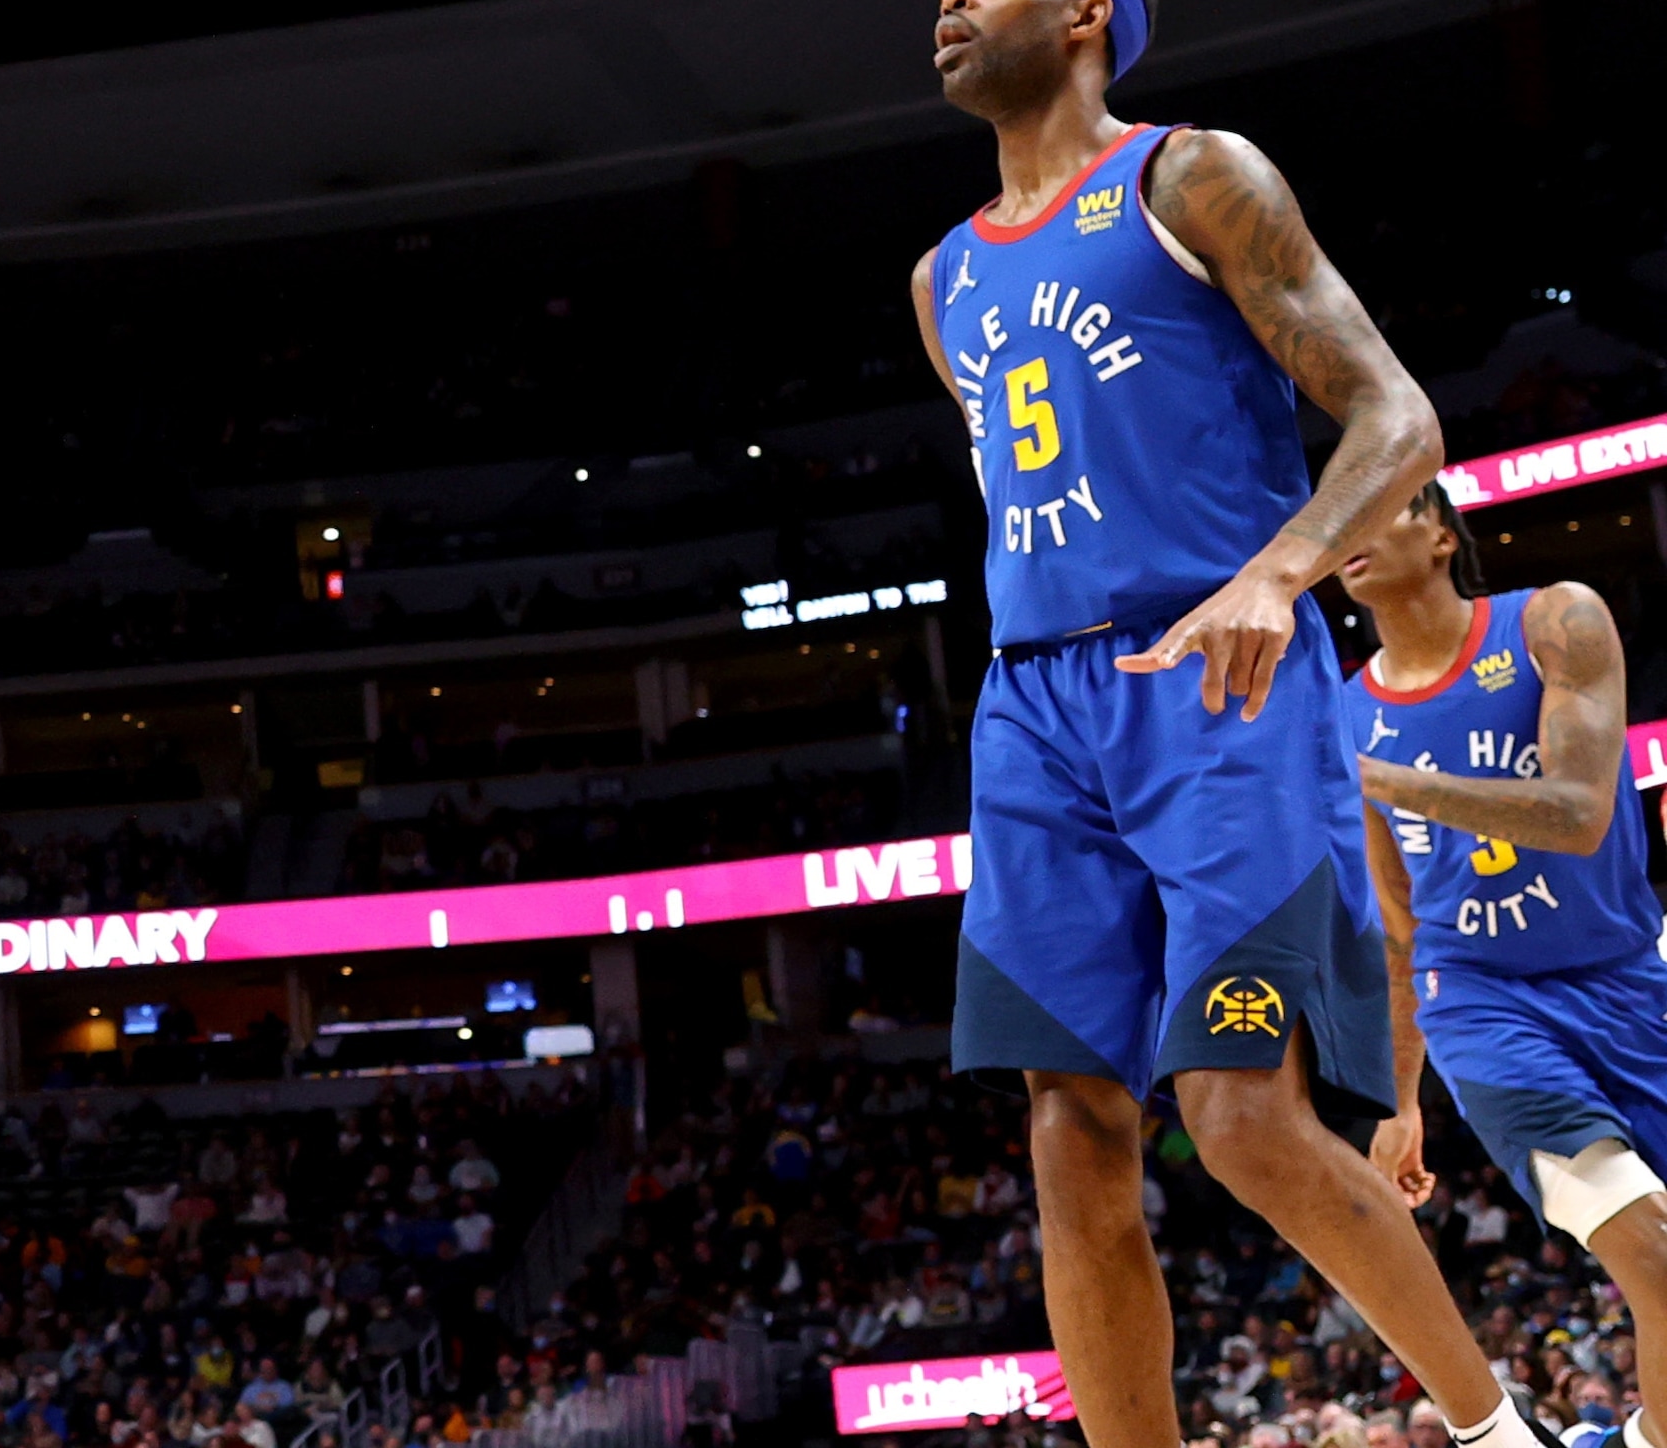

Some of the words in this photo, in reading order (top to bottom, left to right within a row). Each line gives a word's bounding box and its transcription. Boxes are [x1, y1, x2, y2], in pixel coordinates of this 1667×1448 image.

[1077, 183, 1124, 217] WU
[955, 304, 1009, 438] MILE
[1030, 280, 1143, 382] HIGH
[1004, 356, 1061, 473] 5
[1005, 474, 1104, 555] CITY
[1470, 647, 1514, 679] WU
[1467, 729, 1542, 780] HIG
[802, 837, 942, 908] LIVE
[1456, 873, 1560, 938] CITY
